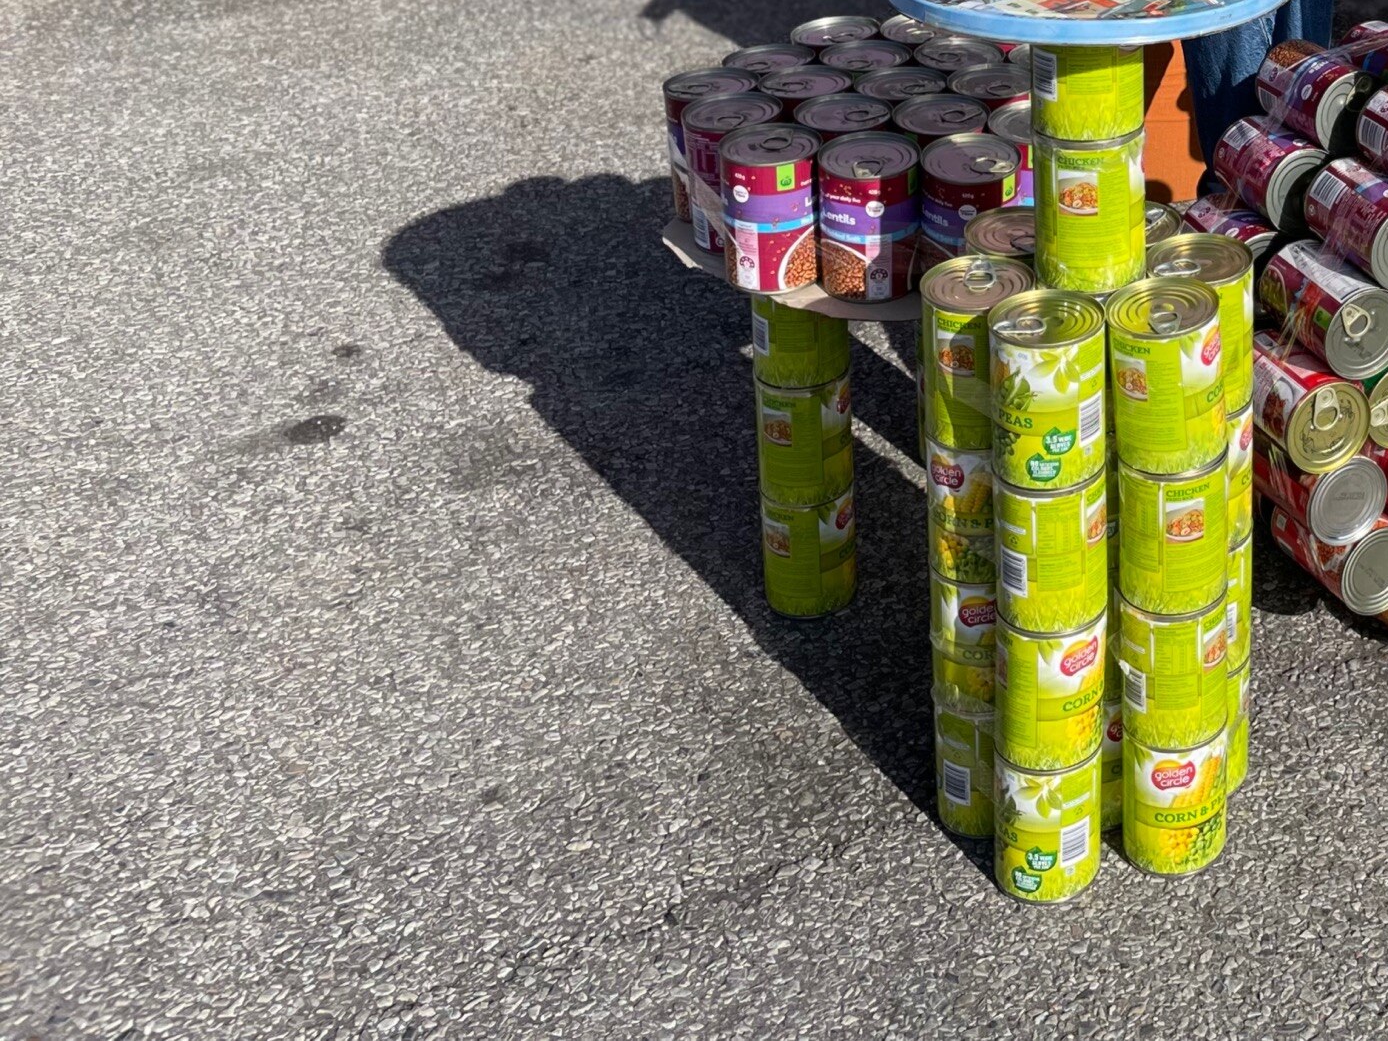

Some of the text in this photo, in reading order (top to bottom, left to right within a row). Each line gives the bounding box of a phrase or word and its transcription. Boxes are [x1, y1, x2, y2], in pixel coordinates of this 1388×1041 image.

[821, 207, 856, 226] Lentils
[937, 317, 982, 330] CHICKEN
[932, 464, 961, 477] golden
[934, 474, 958, 486] circle
[1166, 482, 1210, 498] CHICKEN
[962, 649, 994, 661] COR
[1062, 641, 1098, 667] golden
[1069, 653, 1095, 673] circle
[1154, 764, 1194, 783] golden
[1160, 773, 1191, 788] circle
[1154, 810, 1197, 825] CORN
[1200, 805, 1208, 816] &
